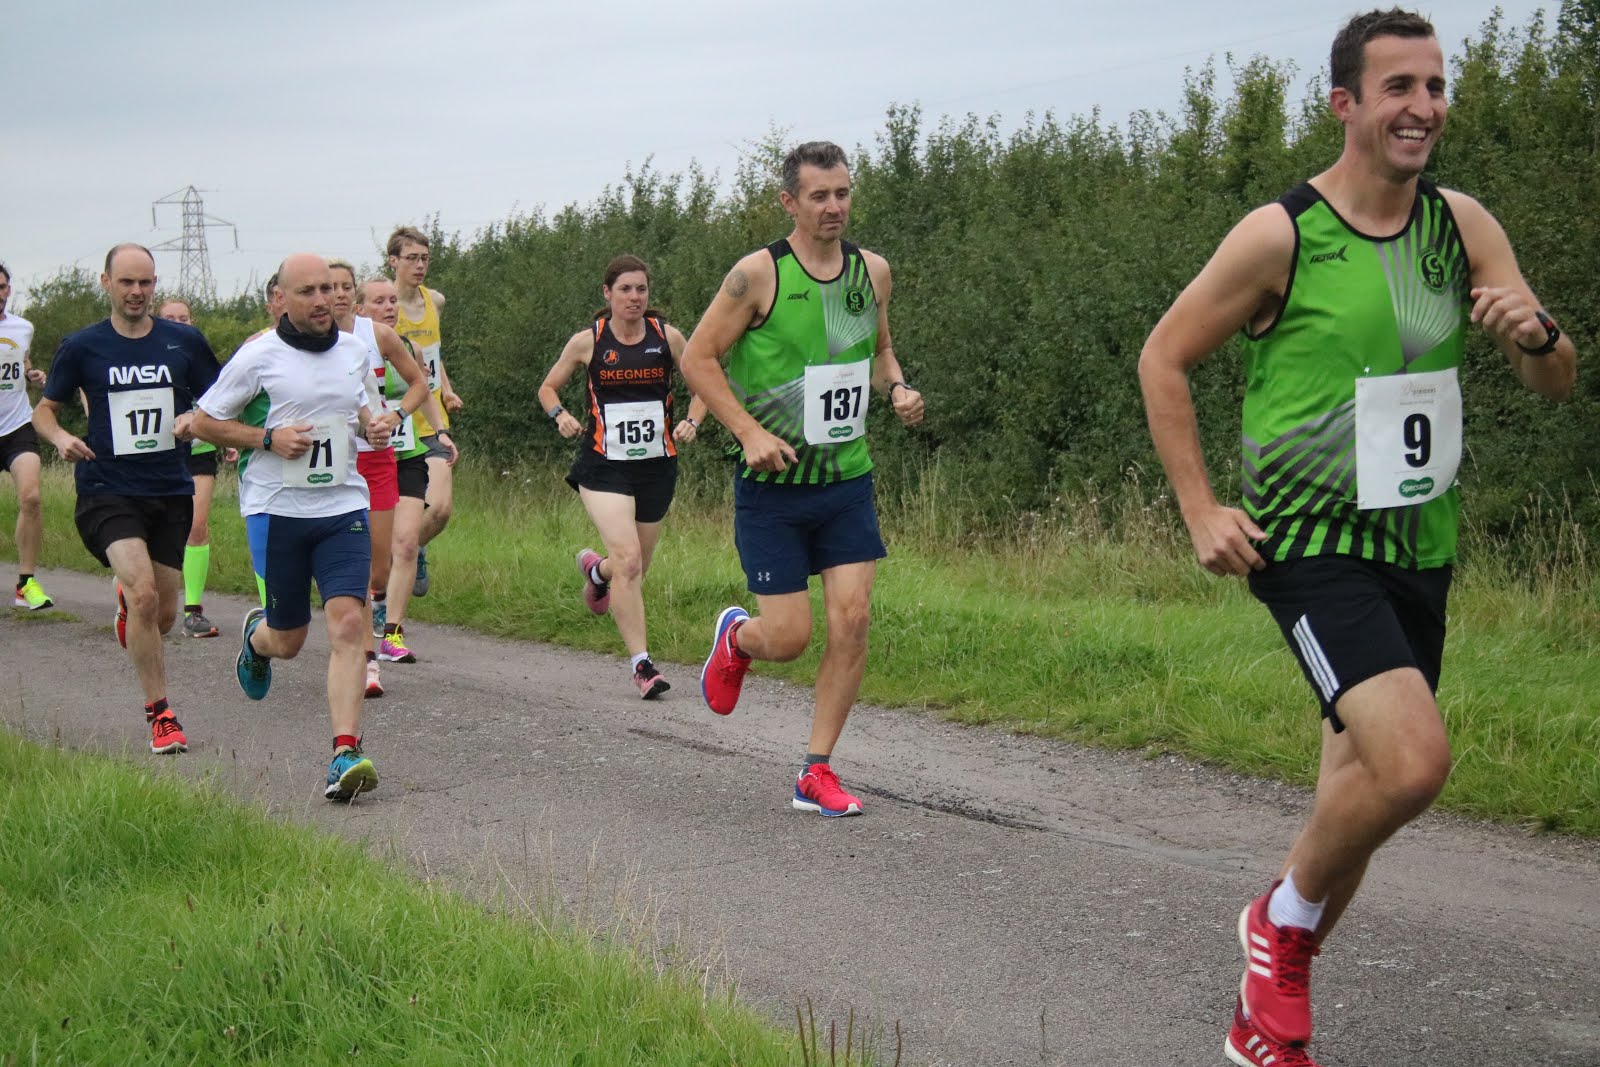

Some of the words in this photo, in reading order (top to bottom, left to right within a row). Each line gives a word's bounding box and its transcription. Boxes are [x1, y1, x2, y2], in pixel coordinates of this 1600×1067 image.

[0, 362, 20, 381] 26
[109, 365, 172, 385] NASA
[600, 368, 664, 380] SKEGNESS
[819, 385, 862, 422] 137
[125, 407, 162, 436] 177
[615, 419, 656, 445] 153
[309, 438, 333, 469] 71
[1403, 413, 1431, 469] 9
